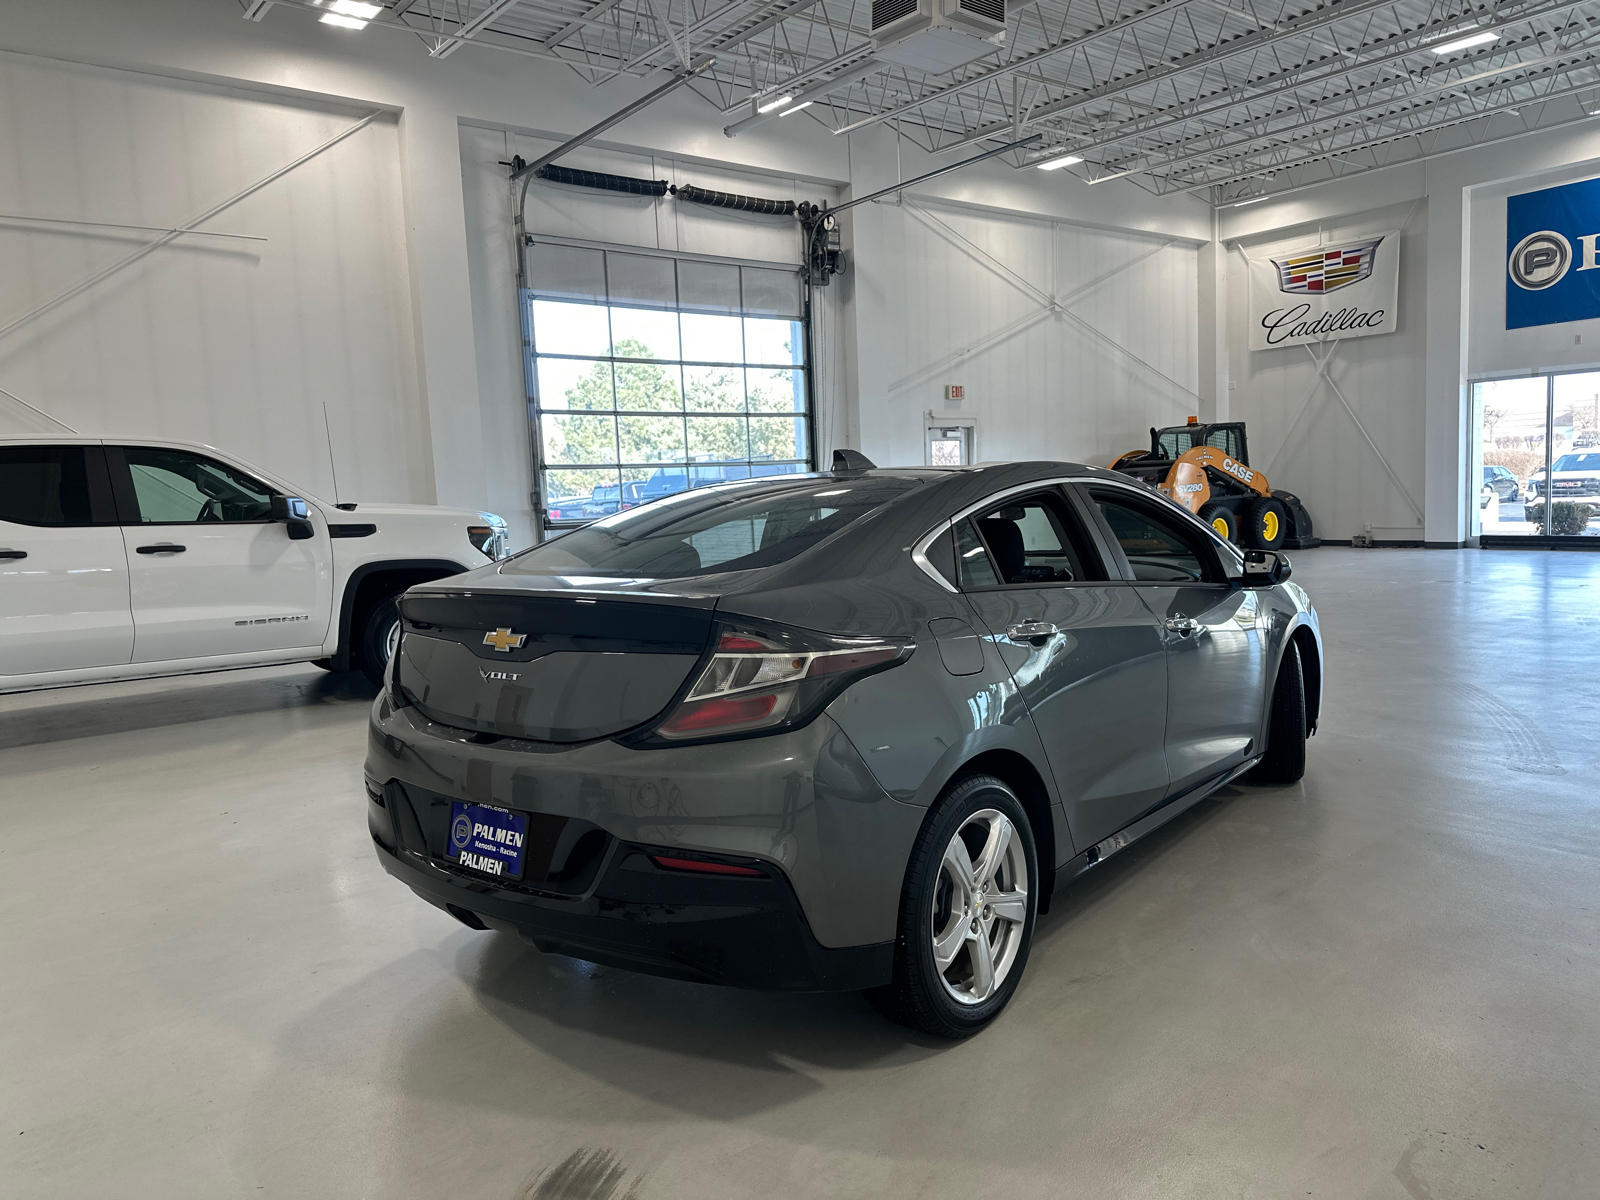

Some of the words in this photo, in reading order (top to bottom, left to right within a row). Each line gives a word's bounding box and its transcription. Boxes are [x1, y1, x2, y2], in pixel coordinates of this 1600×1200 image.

[1262, 303, 1385, 344] Cadillac
[951, 385, 963, 398] EXIT
[1223, 458, 1254, 483] CASE
[1178, 483, 1203, 493] SV280
[234, 615, 309, 626] SIERRA
[478, 666, 522, 683] VOLT
[473, 823, 524, 848] PALMEN
[475, 840, 496, 852] Kenosha
[500, 846, 518, 858] Racine
[459, 851, 503, 876] PALMEN
